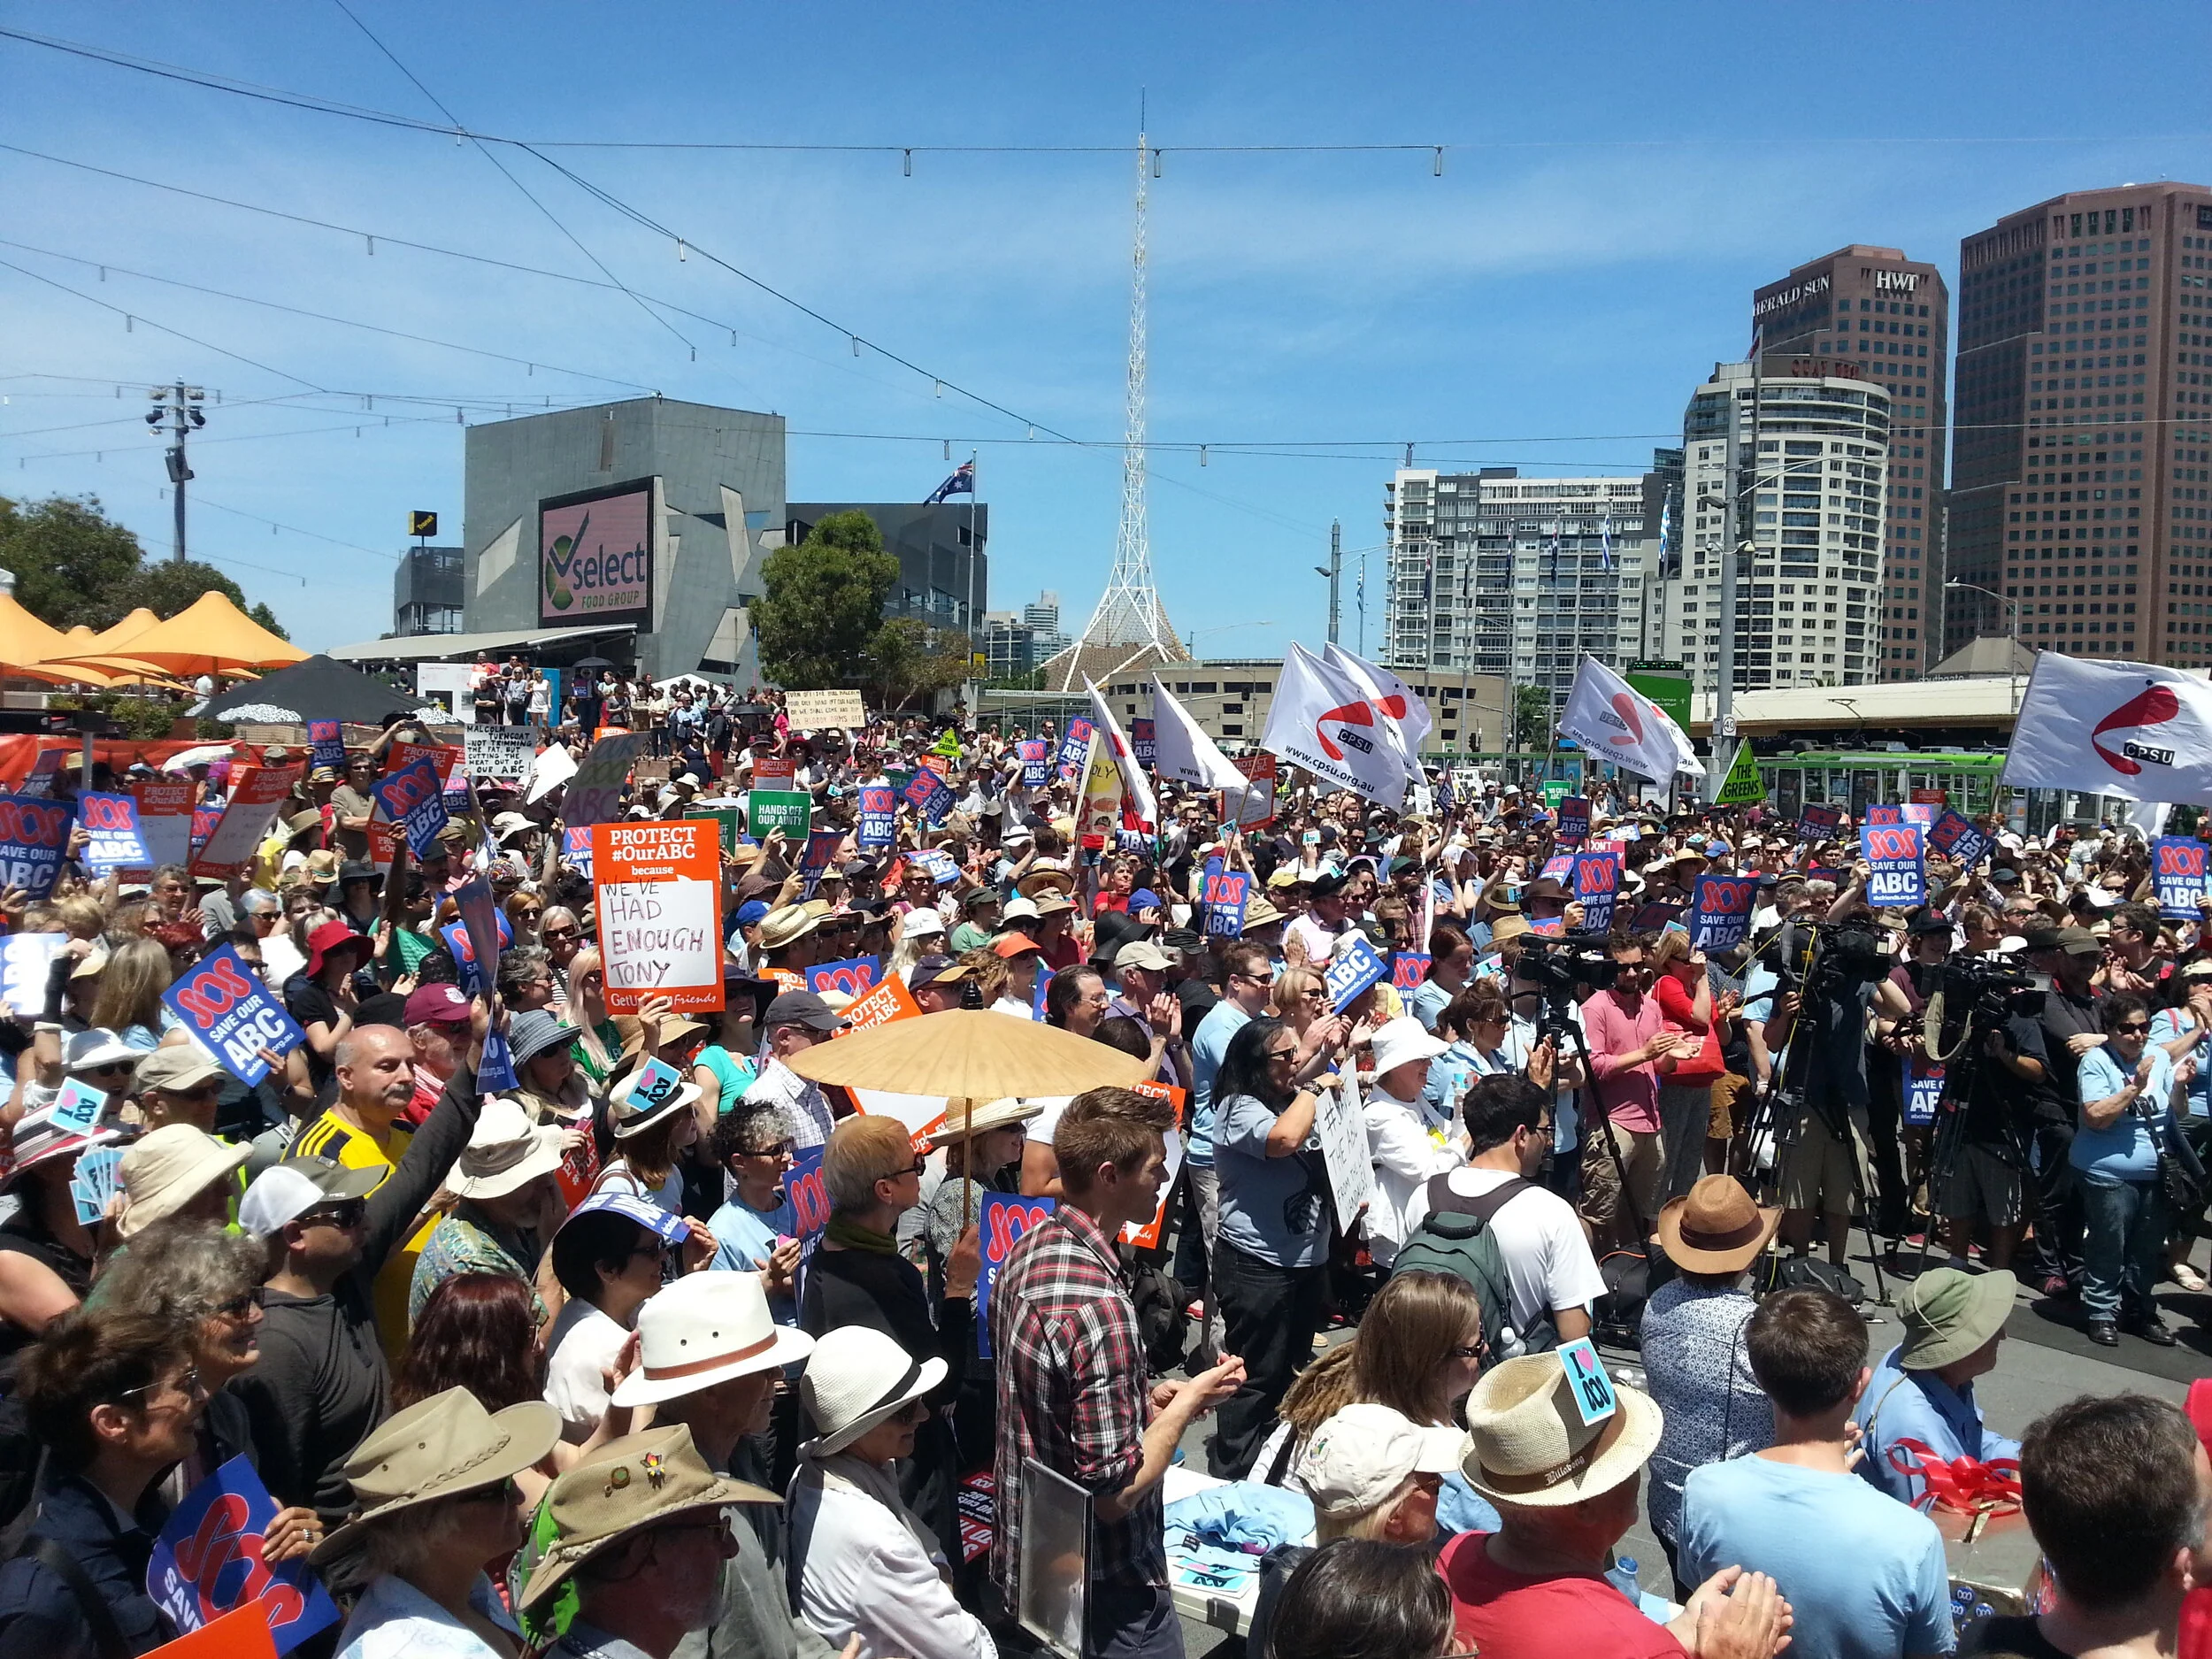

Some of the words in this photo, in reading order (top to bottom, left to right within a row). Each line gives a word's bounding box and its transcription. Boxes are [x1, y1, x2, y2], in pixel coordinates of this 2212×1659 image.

[1753, 288, 1801, 317] HERALD
[1805, 274, 1830, 296] SUN
[573, 541, 645, 590] select
[582, 595, 604, 609] FOOD
[608, 591, 640, 606] GROUP
[1724, 720, 1734, 729] 40
[1340, 729, 1372, 754] CPSU
[314, 747, 342, 761] ABC
[403, 746, 449, 759] PROTECT
[2126, 743, 2175, 765] CPSU
[1025, 767, 1045, 780] ABC
[1285, 743, 1375, 794] www.cpsu.org.au
[1735, 763, 1752, 779] THE
[144, 787, 188, 795] PROTECT
[1724, 780, 1761, 798] GREENS
[422, 793, 438, 810] OUR
[443, 796, 468, 806] ABC
[758, 804, 787, 815] HANDS
[789, 806, 803, 816] OFF
[926, 790, 949, 819] ABC
[407, 802, 442, 847] ABC
[758, 815, 775, 825] OUR
[778, 815, 803, 826] AUNTY
[863, 821, 892, 836] ABC
[1561, 823, 1586, 833] ABC
[114, 831, 135, 840] OUR
[610, 826, 696, 846] PROTECT
[1800, 825, 1831, 839] ABC
[88, 841, 143, 858] ABC
[1948, 839, 1964, 855] SAVE
[1961, 828, 1975, 841] OUR
[0, 845, 27, 858] AVE
[30, 849, 57, 860] OUR
[611, 843, 695, 862] #OurABC
[631, 865, 674, 876] because
[1870, 861, 1895, 871] SAVE
[1897, 861, 1916, 870] OUR
[603, 875, 660, 897] WE'VE
[1871, 872, 1918, 894] ABC
[2159, 876, 2183, 886] SAVE
[2185, 877, 2201, 887] OUR
[1581, 895, 1599, 905] SAVE
[1599, 895, 1612, 904] OUR
[2159, 887, 2202, 909] ABC
[610, 897, 662, 924] HAD
[1223, 905, 1239, 915] OUR
[1700, 915, 1725, 925] SAVE
[1727, 915, 1745, 925] OUR
[611, 928, 704, 956] ENOUGH
[1696, 926, 1742, 952] ABC
[611, 960, 671, 988] TONY
[1327, 949, 1371, 999] ABC
[611, 993, 639, 1007] GetU
[673, 993, 717, 1005] Friends
[209, 1013, 240, 1043] SAVE
[235, 995, 264, 1018] OUR
[223, 1008, 286, 1071] ABC
[1910, 1079, 1936, 1089] SAVE
[1909, 1090, 1940, 1112] AB
[1569, 1351, 1586, 1379] I
[1544, 1454, 1586, 1487] Billabong
